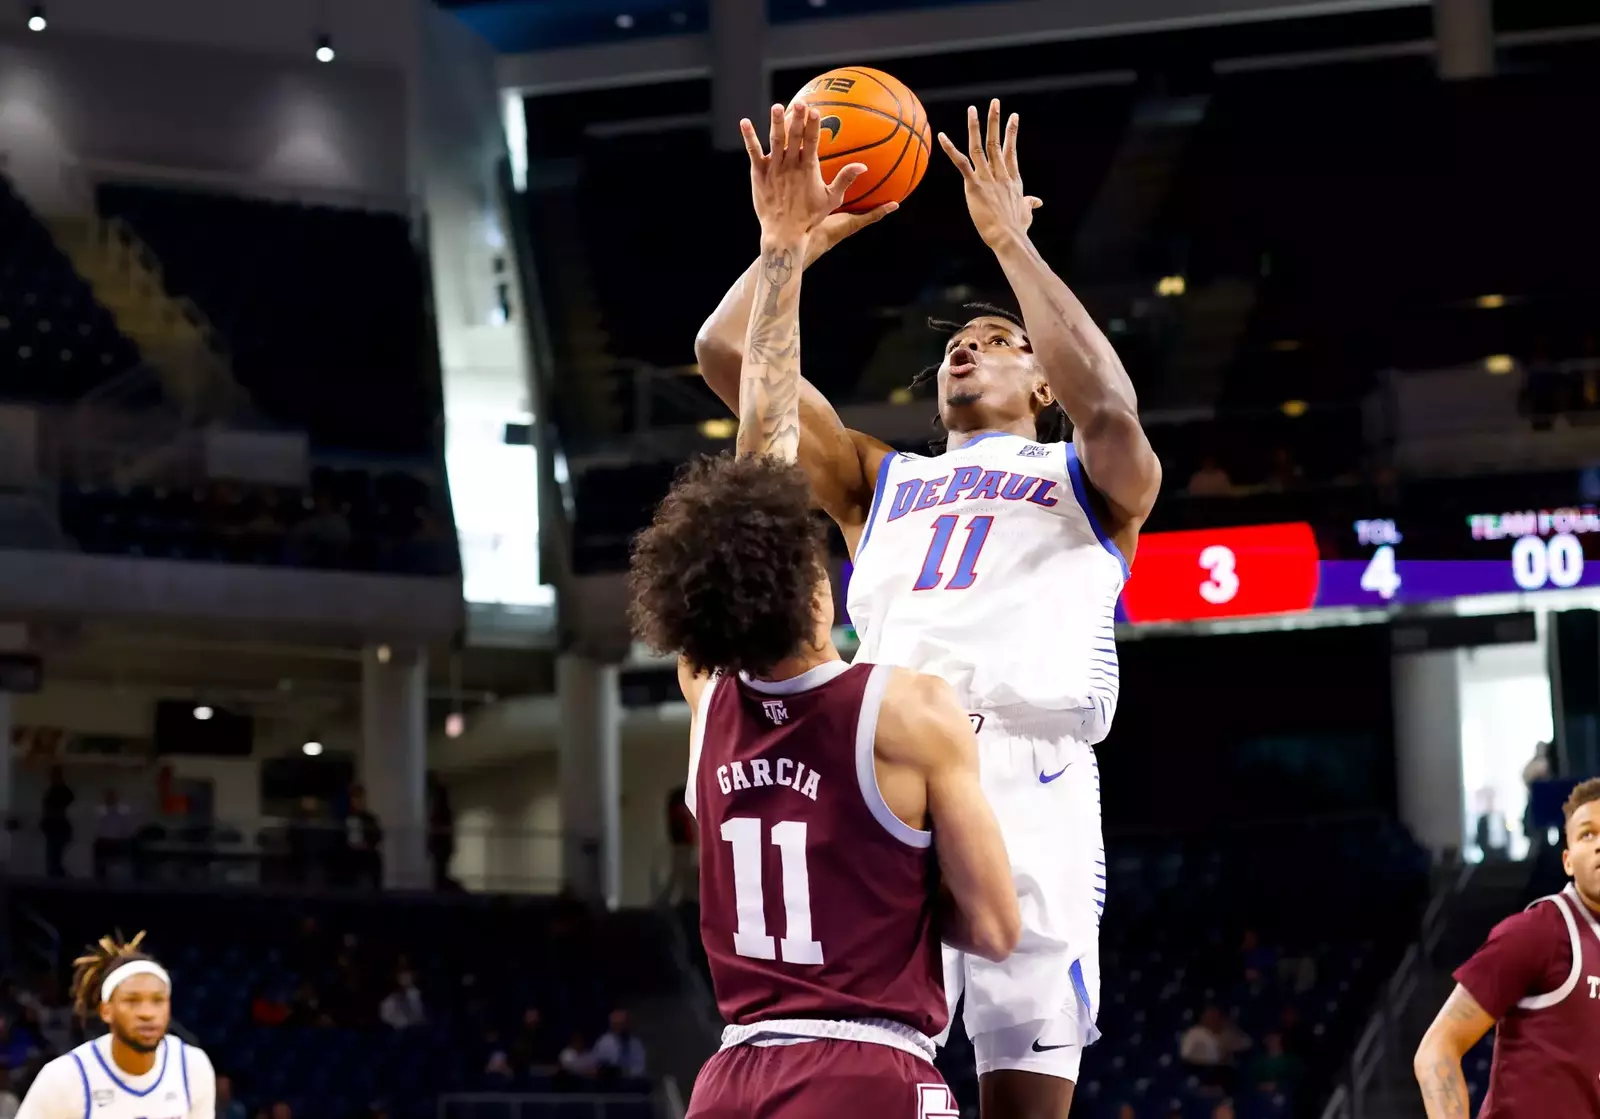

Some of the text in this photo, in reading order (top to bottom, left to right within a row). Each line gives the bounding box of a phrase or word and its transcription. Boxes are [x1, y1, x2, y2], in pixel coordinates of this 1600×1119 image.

[1016, 449, 1052, 458] EAST
[1538, 505, 1600, 535] FOUL
[912, 514, 994, 592] 11
[1198, 545, 1240, 604] 3
[1360, 545, 1402, 599] 4
[1511, 534, 1584, 591] 00
[716, 757, 821, 802] GARCIA
[720, 817, 825, 965] 11
